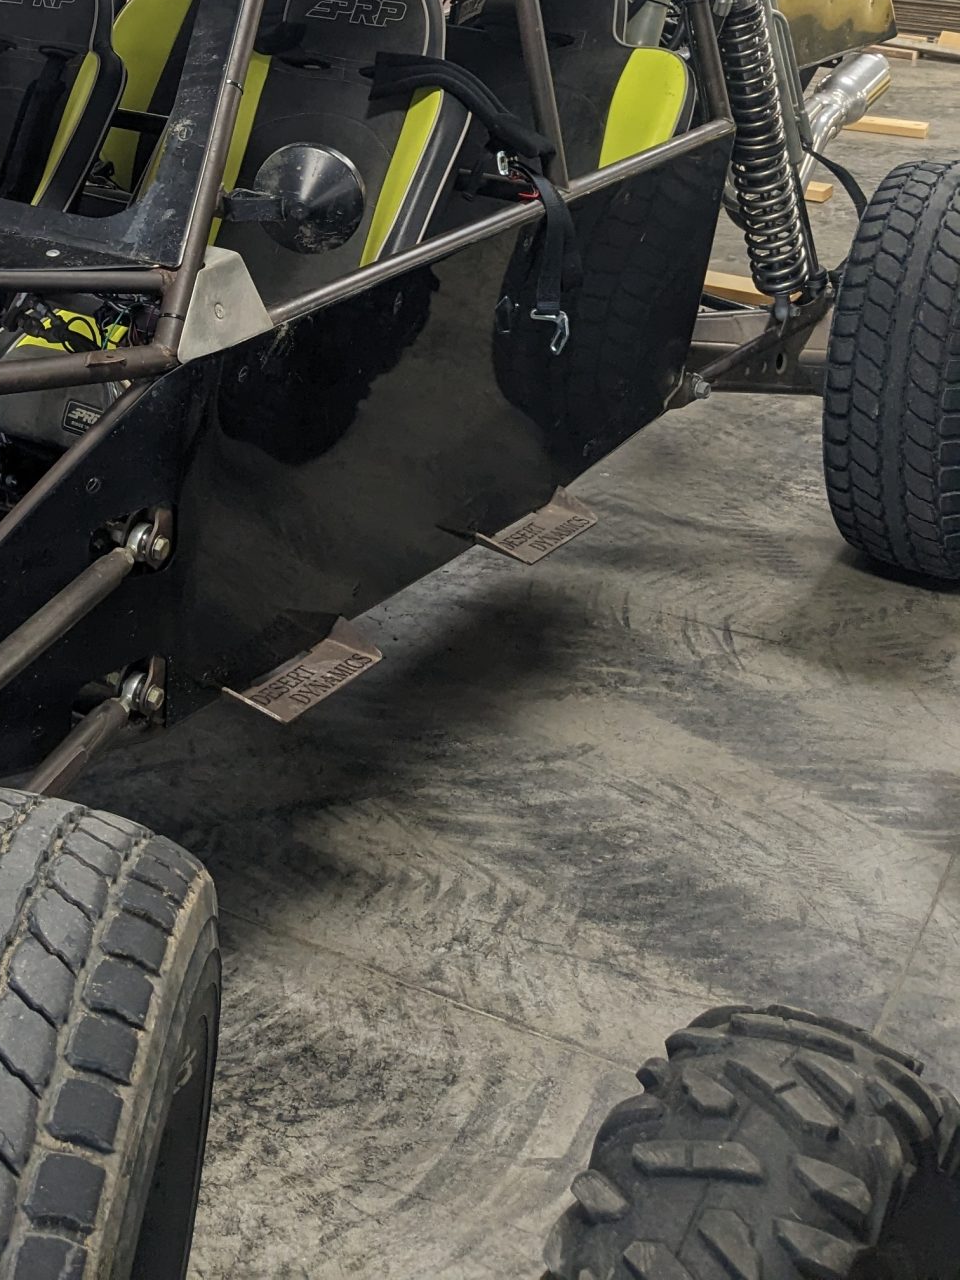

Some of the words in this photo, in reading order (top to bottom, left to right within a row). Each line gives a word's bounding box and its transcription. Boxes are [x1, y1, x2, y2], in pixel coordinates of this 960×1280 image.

[499, 522, 546, 551] DESERT
[528, 515, 590, 553] DYNAMICS
[249, 664, 317, 707] DESERT
[288, 653, 373, 706] DYNAMICS
